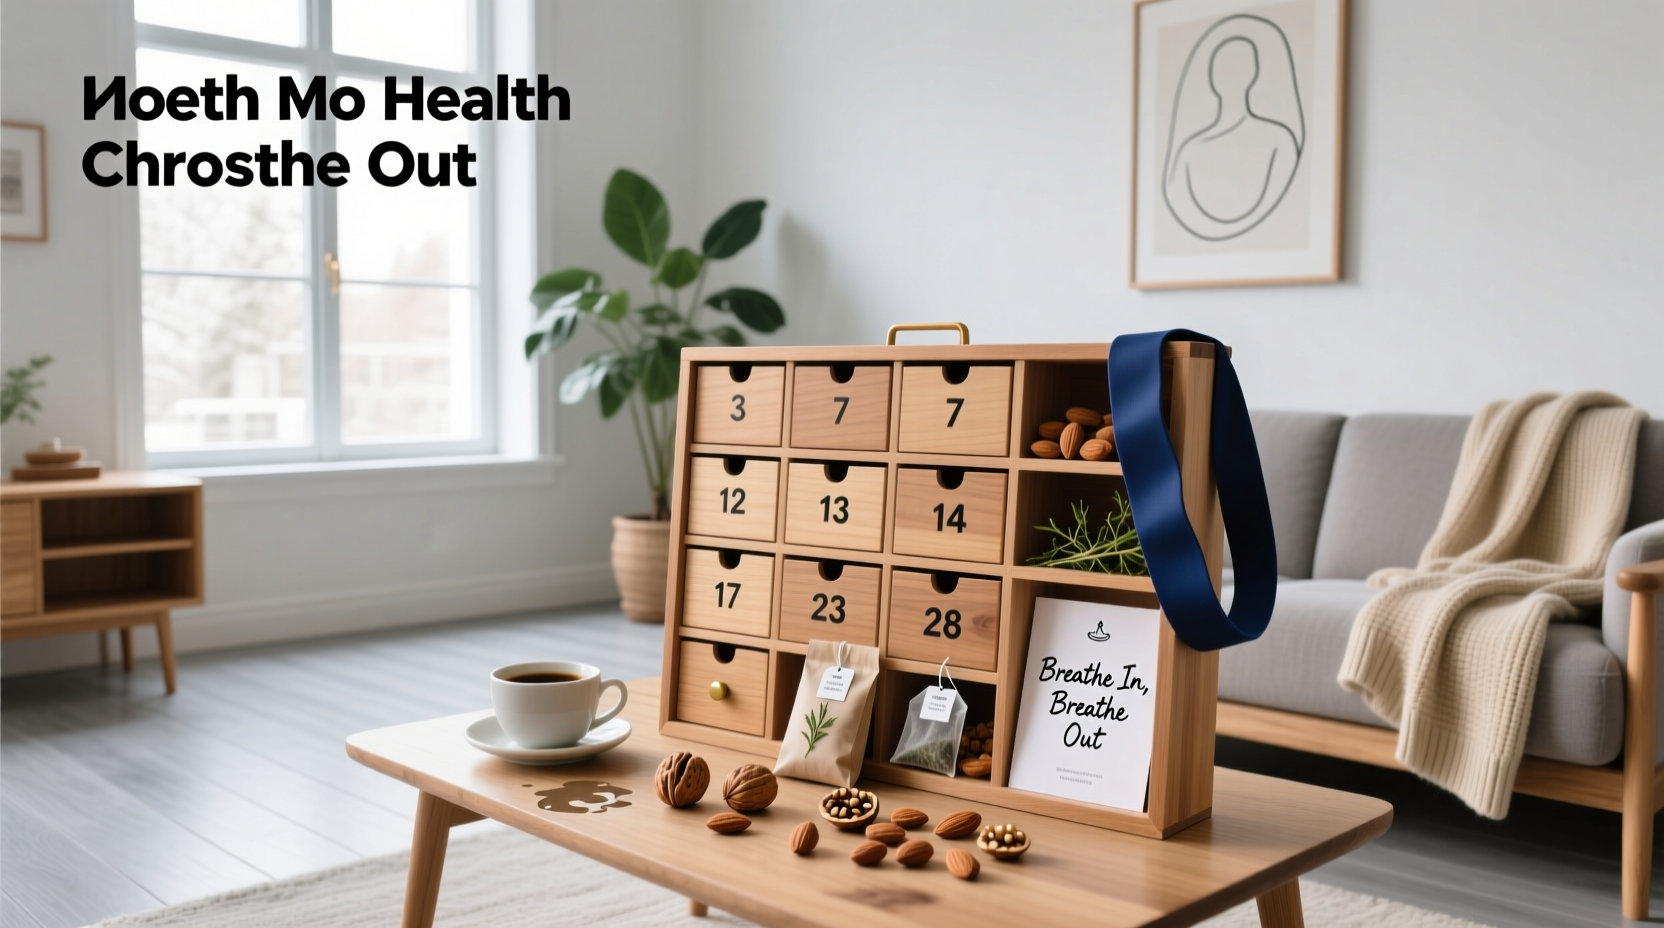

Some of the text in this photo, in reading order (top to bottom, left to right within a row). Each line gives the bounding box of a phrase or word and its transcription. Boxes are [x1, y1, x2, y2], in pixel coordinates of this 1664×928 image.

[730, 394, 746, 422] 3
[833, 396, 850, 425] 7
[946, 397, 965, 428] 7
[719, 487, 746, 515] 12
[819, 495, 849, 524] 13
[932, 502, 967, 533] 14
[714, 581, 742, 609] 17
[810, 592, 846, 624] 23
[922, 606, 962, 640] 28
[1038, 656, 1149, 696] Breathe In,
[1049, 690, 1129, 722] Breathe
[1063, 721, 1107, 750] Out
